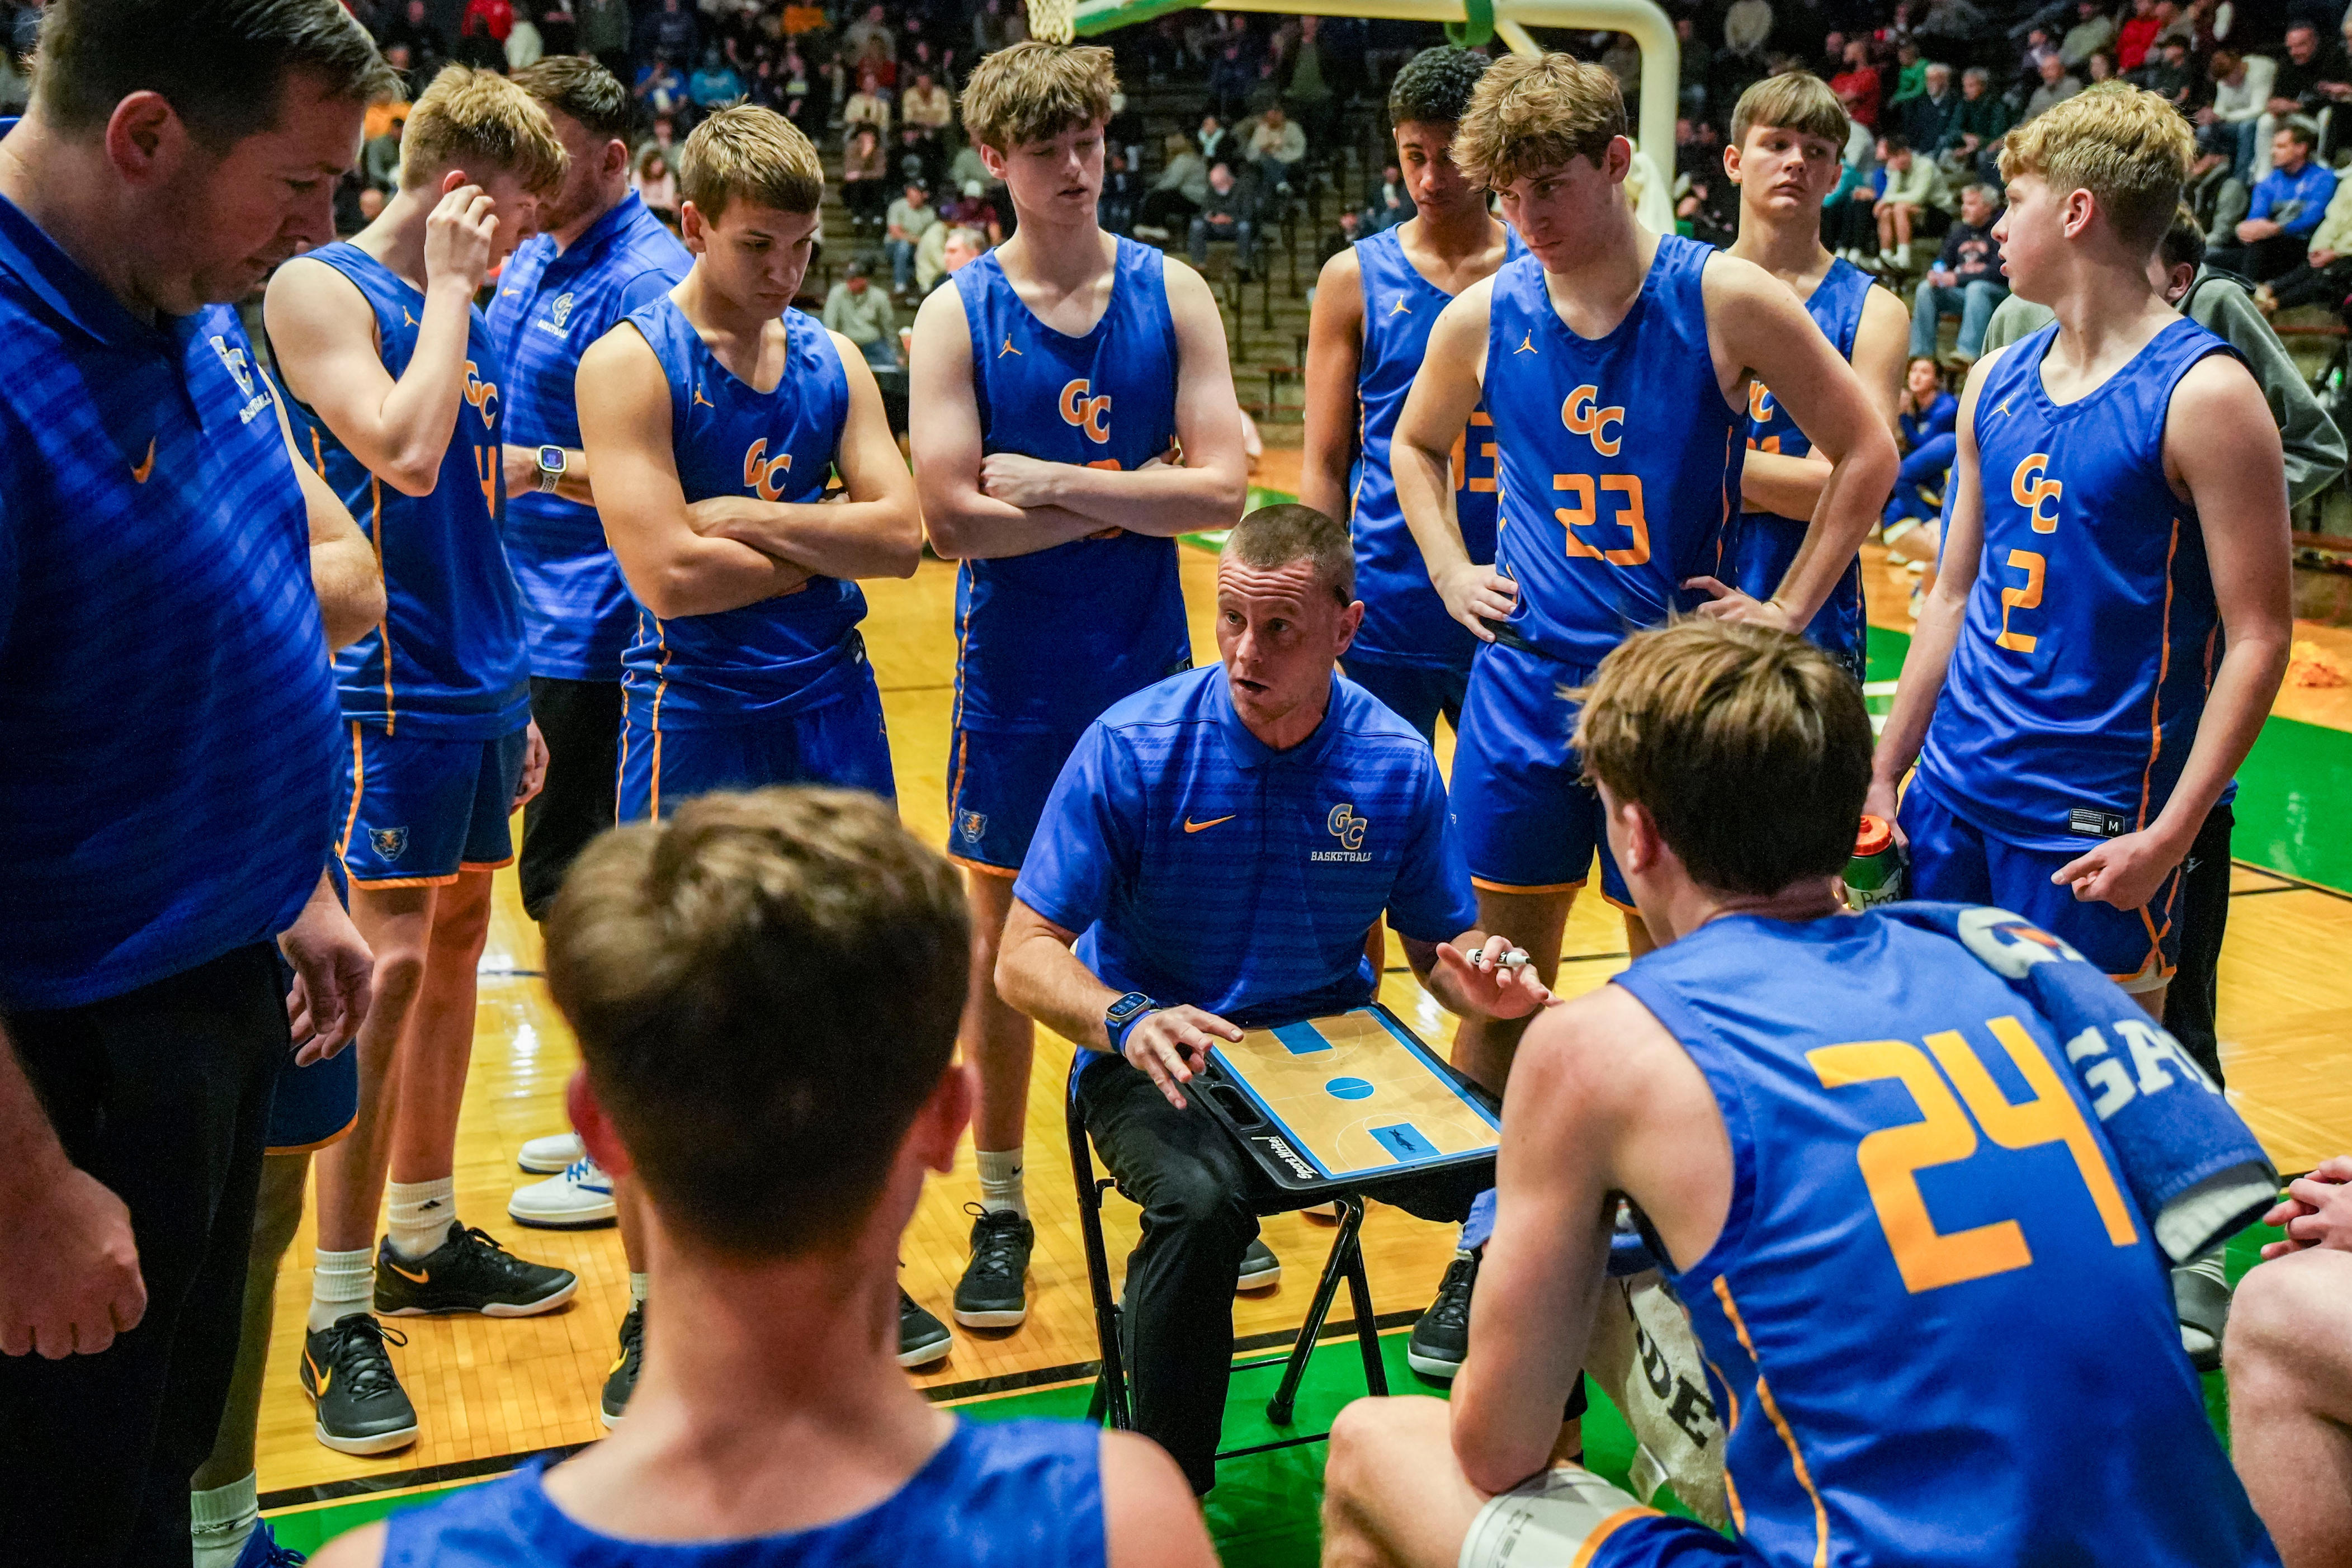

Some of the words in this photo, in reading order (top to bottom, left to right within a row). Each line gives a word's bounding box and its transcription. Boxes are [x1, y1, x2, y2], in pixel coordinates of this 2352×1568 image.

[1058, 378, 1112, 444] GC
[1561, 384, 1626, 457] GC
[743, 437, 792, 502] GC
[2011, 452, 2063, 535] GC
[1552, 473, 1651, 566] 23
[1995, 548, 2046, 654] 2
[1310, 851, 1372, 862] BASKETBALL
[1327, 803, 1368, 851] GC
[2108, 820, 2119, 832] M
[1805, 1015, 2139, 1295] 24
